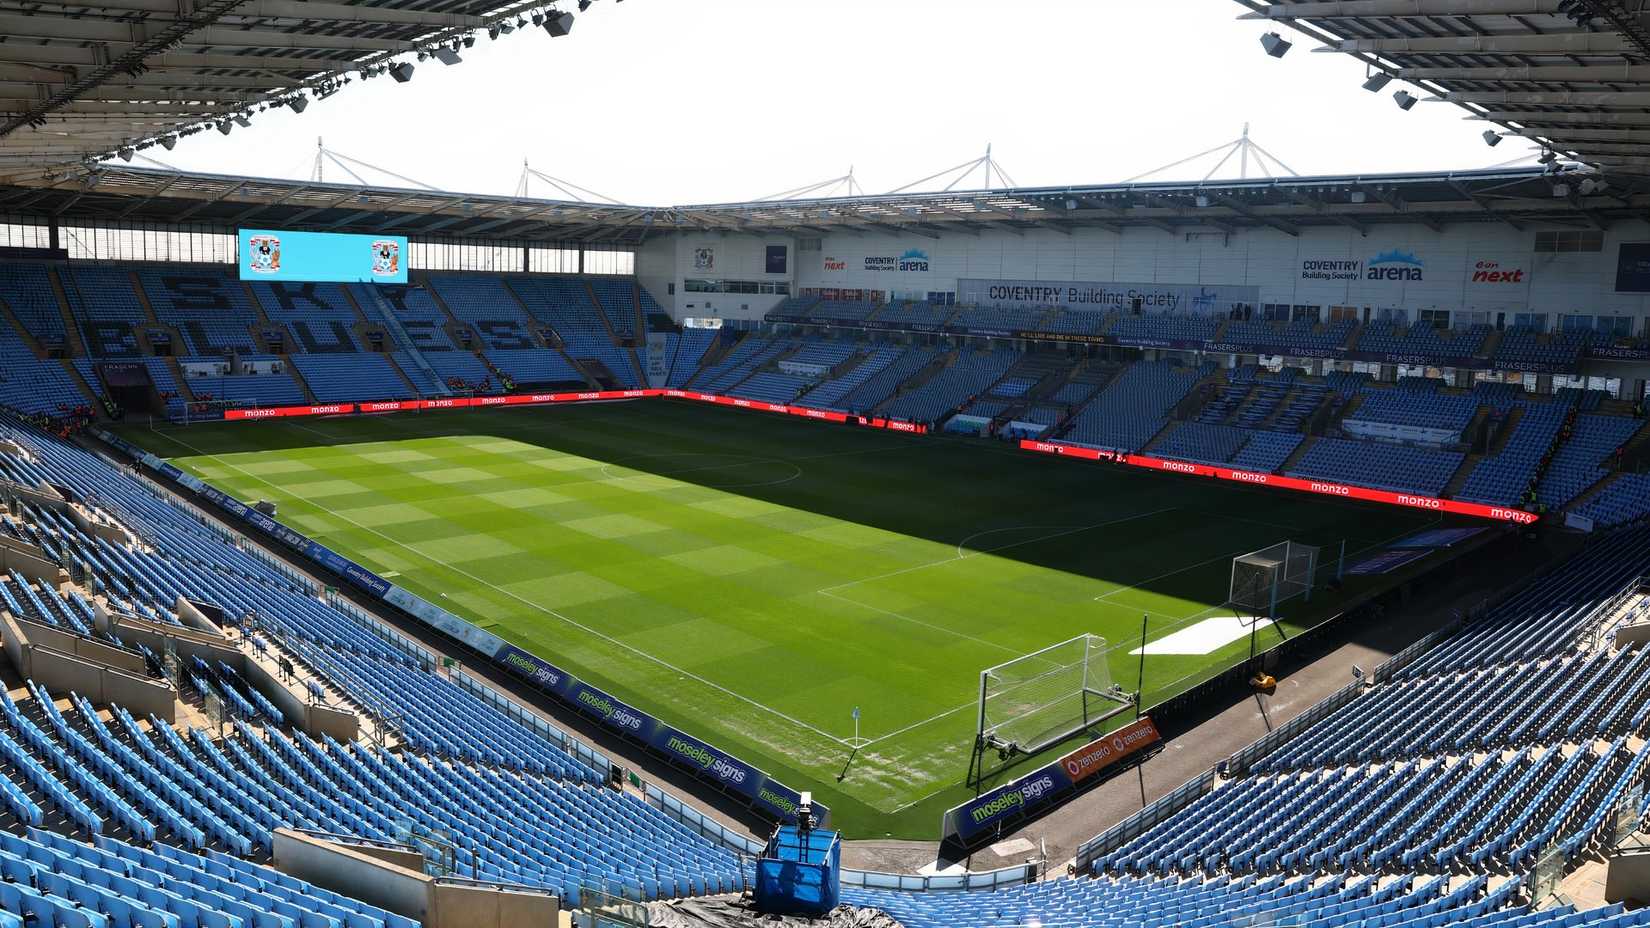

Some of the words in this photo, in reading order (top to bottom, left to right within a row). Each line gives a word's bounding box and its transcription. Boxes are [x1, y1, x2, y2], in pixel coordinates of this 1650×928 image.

[864, 256, 895, 264] COVENTRY
[899, 261, 929, 272] arena
[1303, 260, 1358, 271] COVENTRY
[1302, 271, 1331, 280] Building
[1332, 271, 1358, 280] Society
[1367, 266, 1423, 281] arena
[1472, 269, 1524, 282] next
[989, 285, 1062, 302] COVENTRY
[1068, 287, 1123, 308] Building
[1127, 289, 1180, 310] Society
[244, 408, 276, 417] monzo
[311, 405, 340, 414] monzo
[371, 402, 399, 411] monzo
[482, 397, 506, 405] monzo
[1163, 461, 1195, 473] monzo
[1231, 471, 1267, 484] monzo
[1311, 482, 1349, 496] monzo
[1397, 495, 1440, 509] monzo
[1491, 507, 1532, 524] monzo
[1122, 724, 1153, 746] zenzero
[1078, 745, 1111, 769] zenzero
